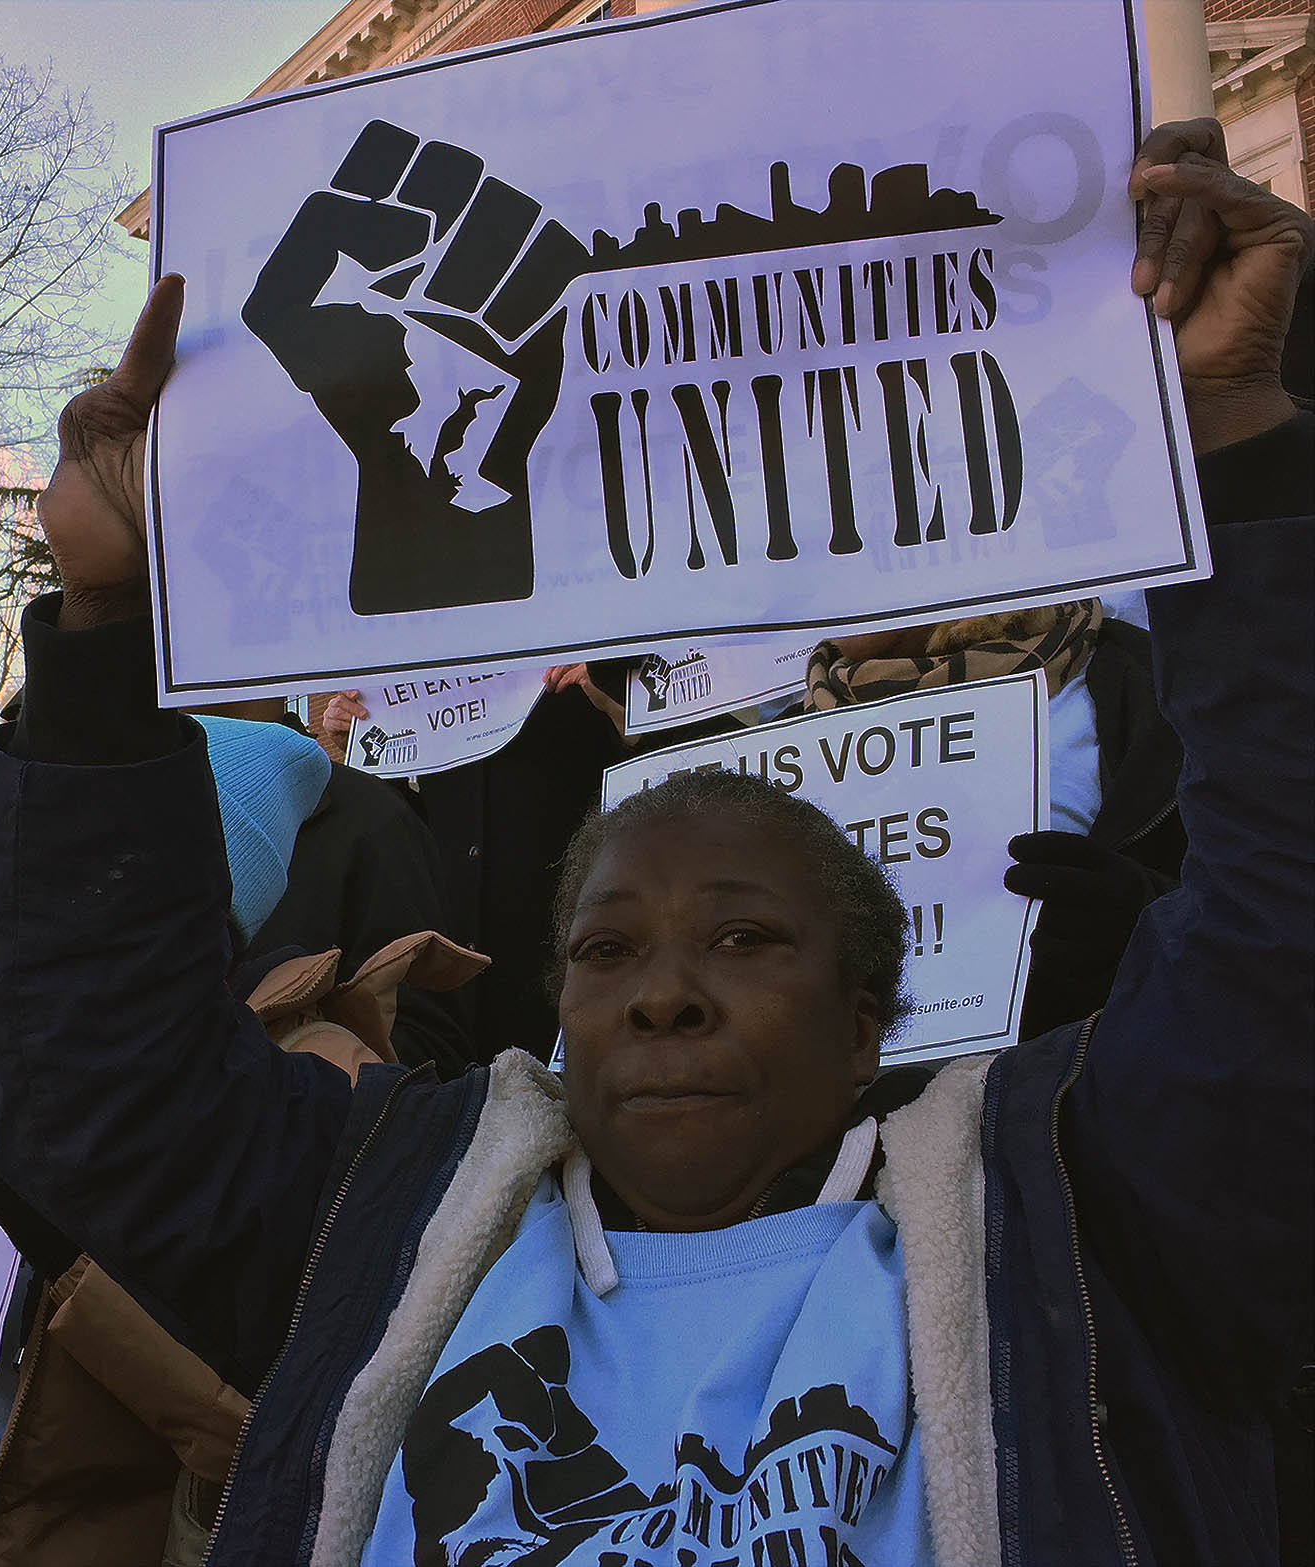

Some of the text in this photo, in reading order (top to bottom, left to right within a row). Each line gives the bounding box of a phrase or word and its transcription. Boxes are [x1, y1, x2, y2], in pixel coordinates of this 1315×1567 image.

[581, 247, 998, 375] COMMUNITIES
[589, 349, 1024, 579] UNITED
[383, 681, 419, 707] LET
[672, 673, 713, 705] UNITED
[426, 698, 488, 732] VOTE!
[384, 743, 418, 765] UNITED
[818, 710, 977, 784] VOTE
